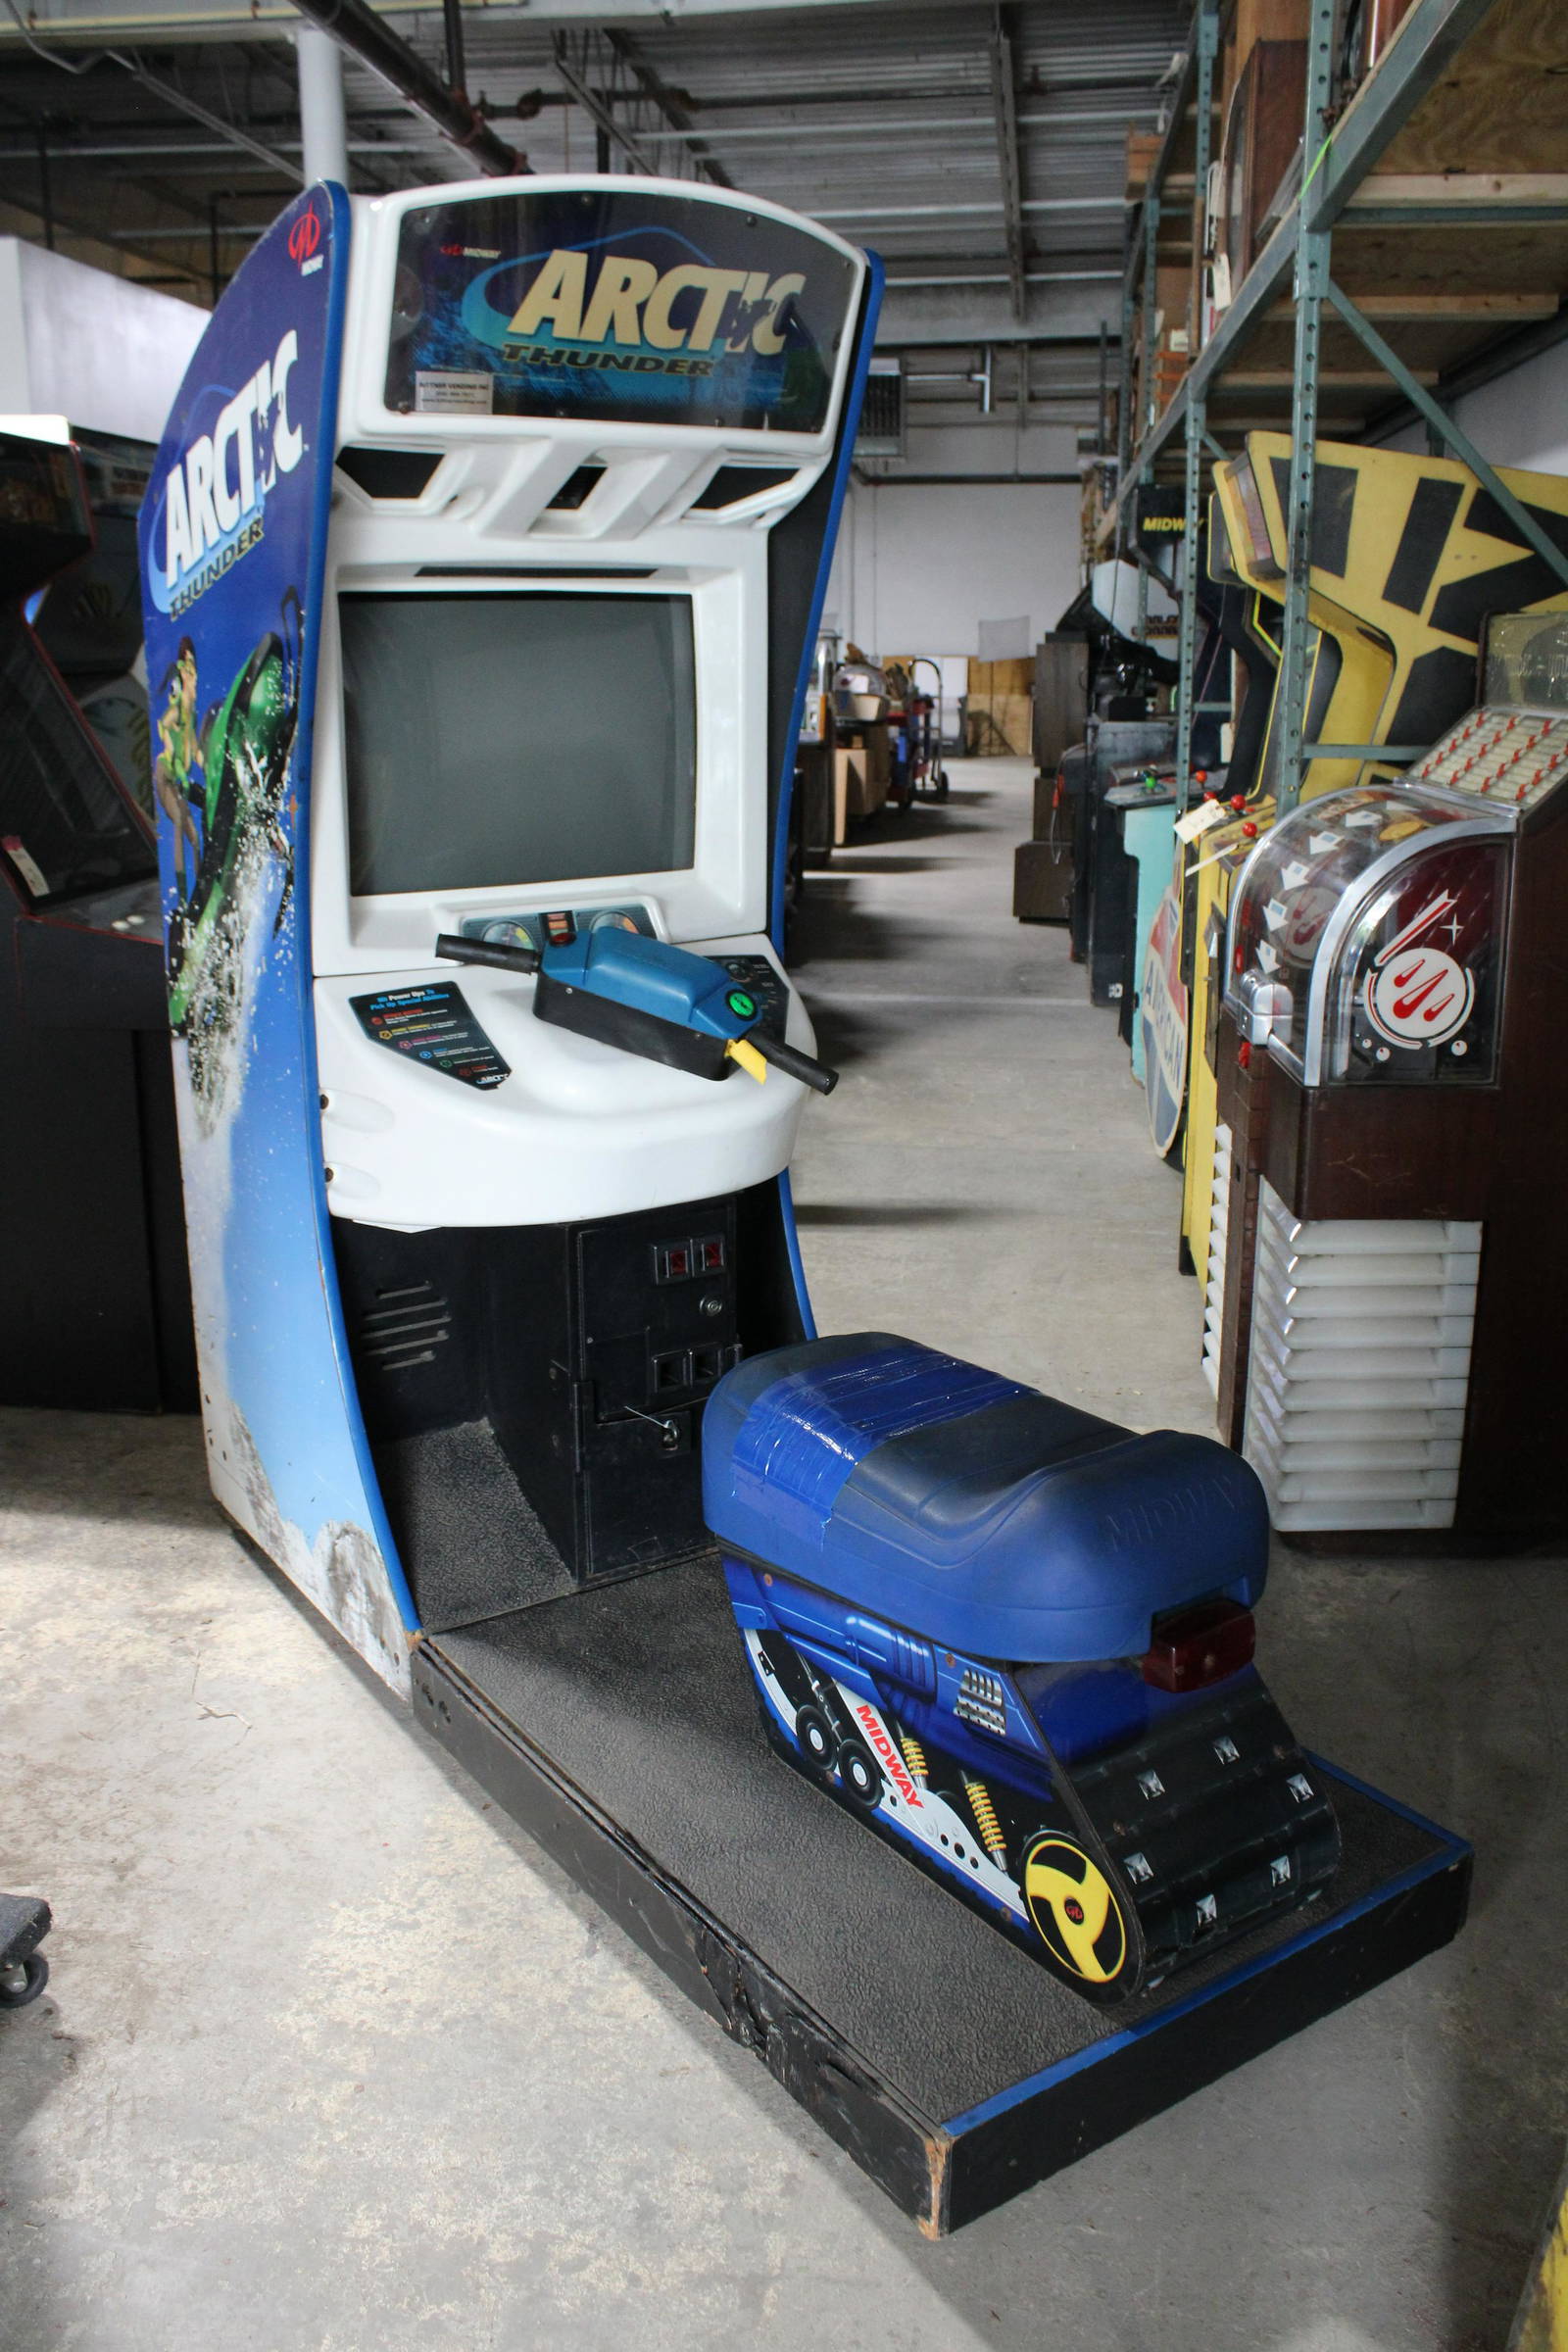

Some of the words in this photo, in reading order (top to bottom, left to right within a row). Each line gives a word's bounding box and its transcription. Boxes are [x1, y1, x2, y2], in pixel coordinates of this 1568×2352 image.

[506, 248, 807, 356] ARCTIC
[503, 343, 714, 376] THUNDER
[166, 328, 302, 589] ARCTIC
[170, 516, 265, 622] THUNDER
[856, 1704, 925, 1809] MIDWAY
